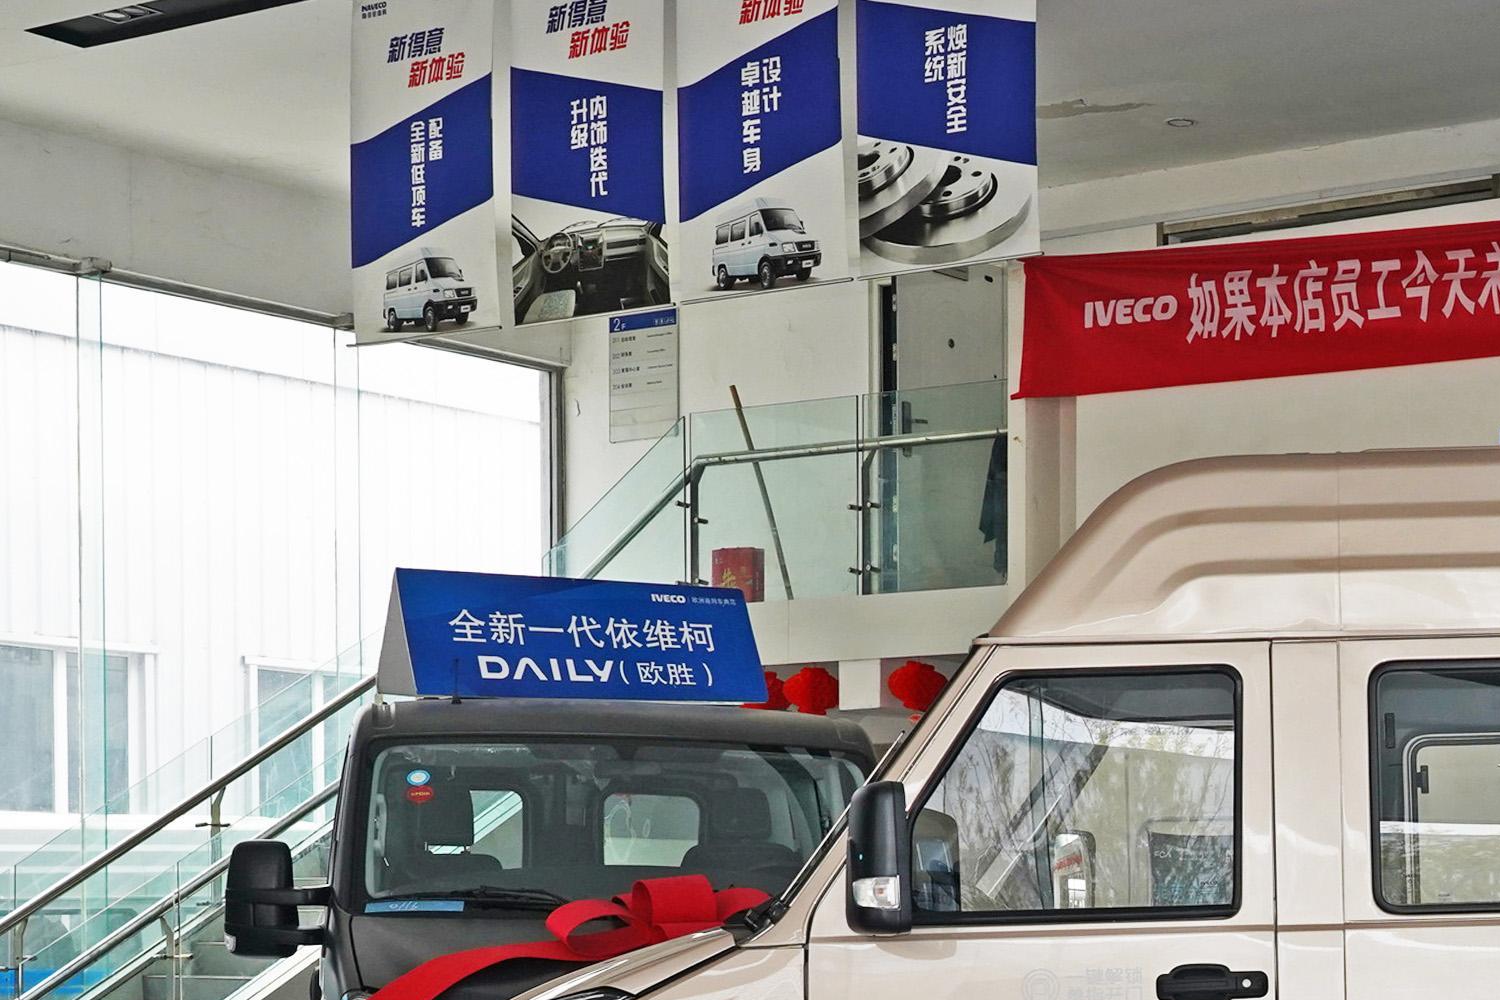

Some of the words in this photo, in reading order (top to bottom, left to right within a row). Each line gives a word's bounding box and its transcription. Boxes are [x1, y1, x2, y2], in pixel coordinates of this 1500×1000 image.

[546, 0, 608, 34] 新得意
[387, 27, 445, 63] 新得意
[568, 21, 630, 59] 新体验
[924, 27, 945, 83] 系统
[408, 52, 465, 88] 新体验
[762, 56, 782, 112] 设计
[946, 24, 967, 134] 焕新安全
[428, 117, 443, 161] 配备
[570, 98, 588, 150] 升级
[741, 61, 761, 174] 卓越车身
[590, 95, 608, 197] 内饰迭代
[410, 121, 425, 227] 全新低顶车
[1083, 295, 1178, 329] IVECO
[650, 594, 687, 604] IVECO
[448, 608, 715, 654] 全新一代依维柯
[476, 655, 614, 683] DAILY
